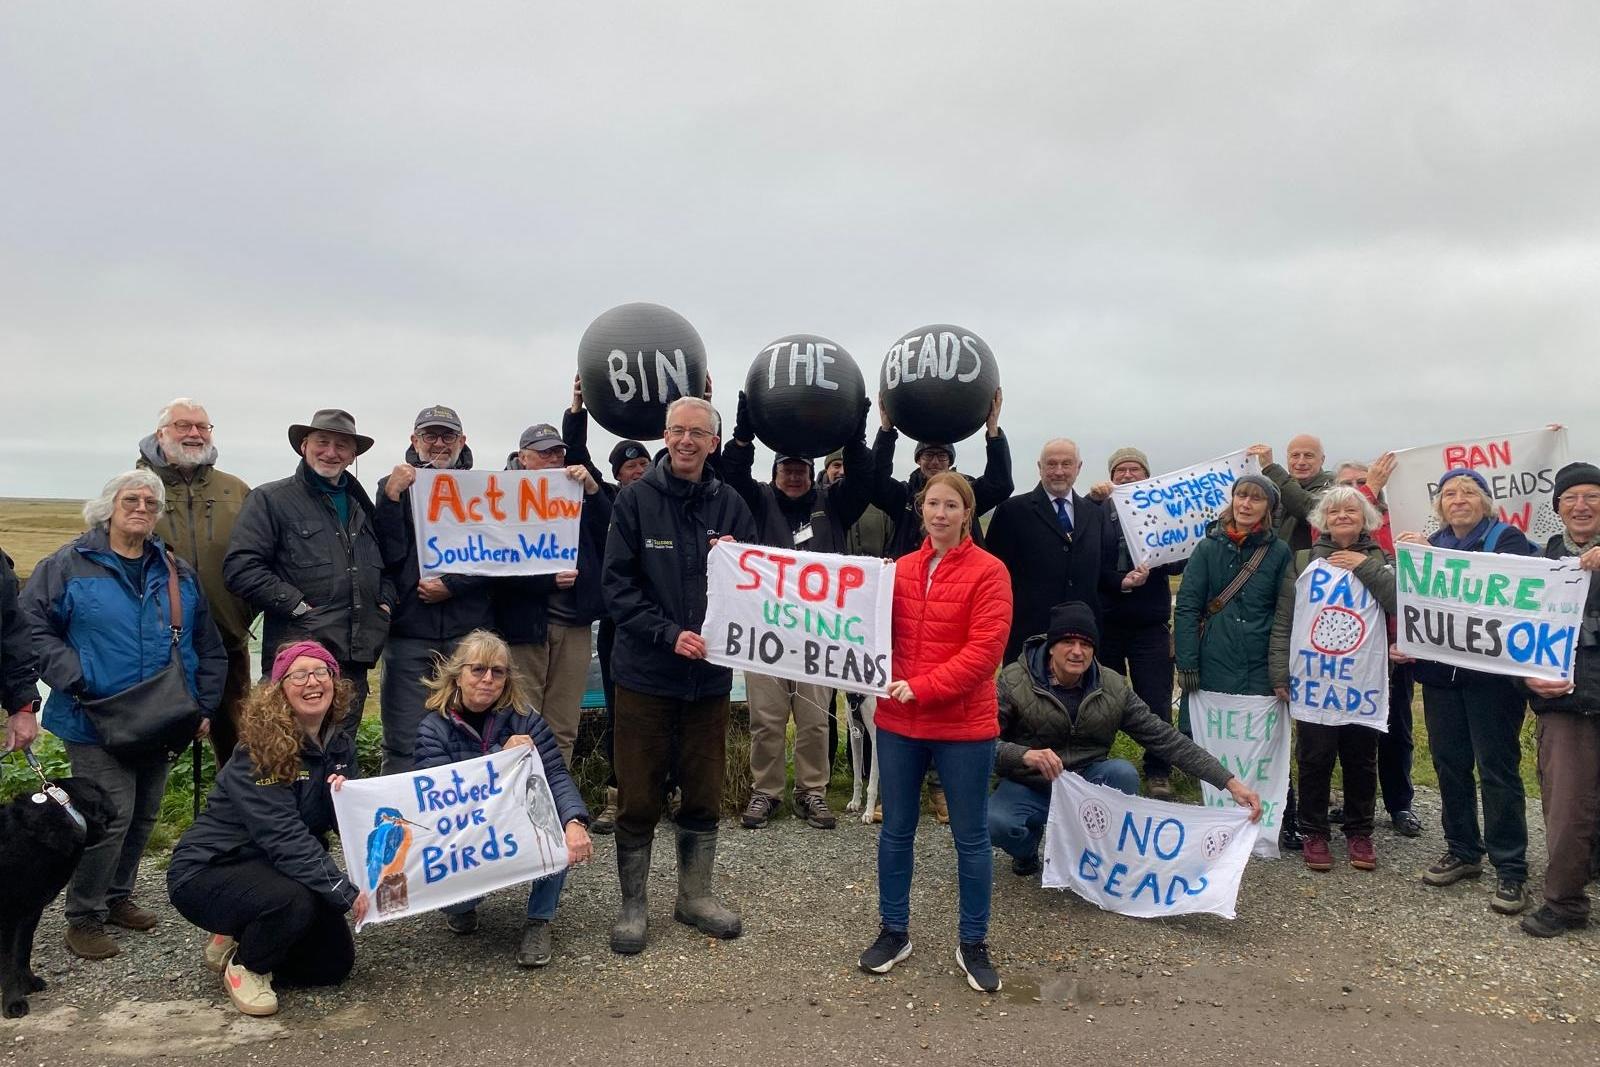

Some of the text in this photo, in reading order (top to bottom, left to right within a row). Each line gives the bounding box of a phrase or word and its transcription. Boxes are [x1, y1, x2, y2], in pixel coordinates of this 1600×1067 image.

[607, 331, 982, 403] BIN THE BEADS
[1445, 440, 1512, 471] BAN
[427, 474, 580, 523] Act Now
[1132, 468, 1236, 509] SOUTHERN
[1166, 489, 1229, 518] WATER
[424, 533, 577, 569] Southern Water
[1146, 526, 1188, 548] CLEAN
[736, 549, 865, 608] STOP
[1398, 549, 1545, 612] NATURE
[763, 600, 864, 645] USING
[1404, 604, 1576, 678] RULES OK!
[725, 621, 887, 688] BIO-BEADS
[1299, 650, 1355, 681] THE
[1289, 675, 1380, 716] BEADS
[1207, 707, 1278, 742] HELP
[1219, 752, 1273, 781] AVE
[1117, 810, 1186, 861] NO
